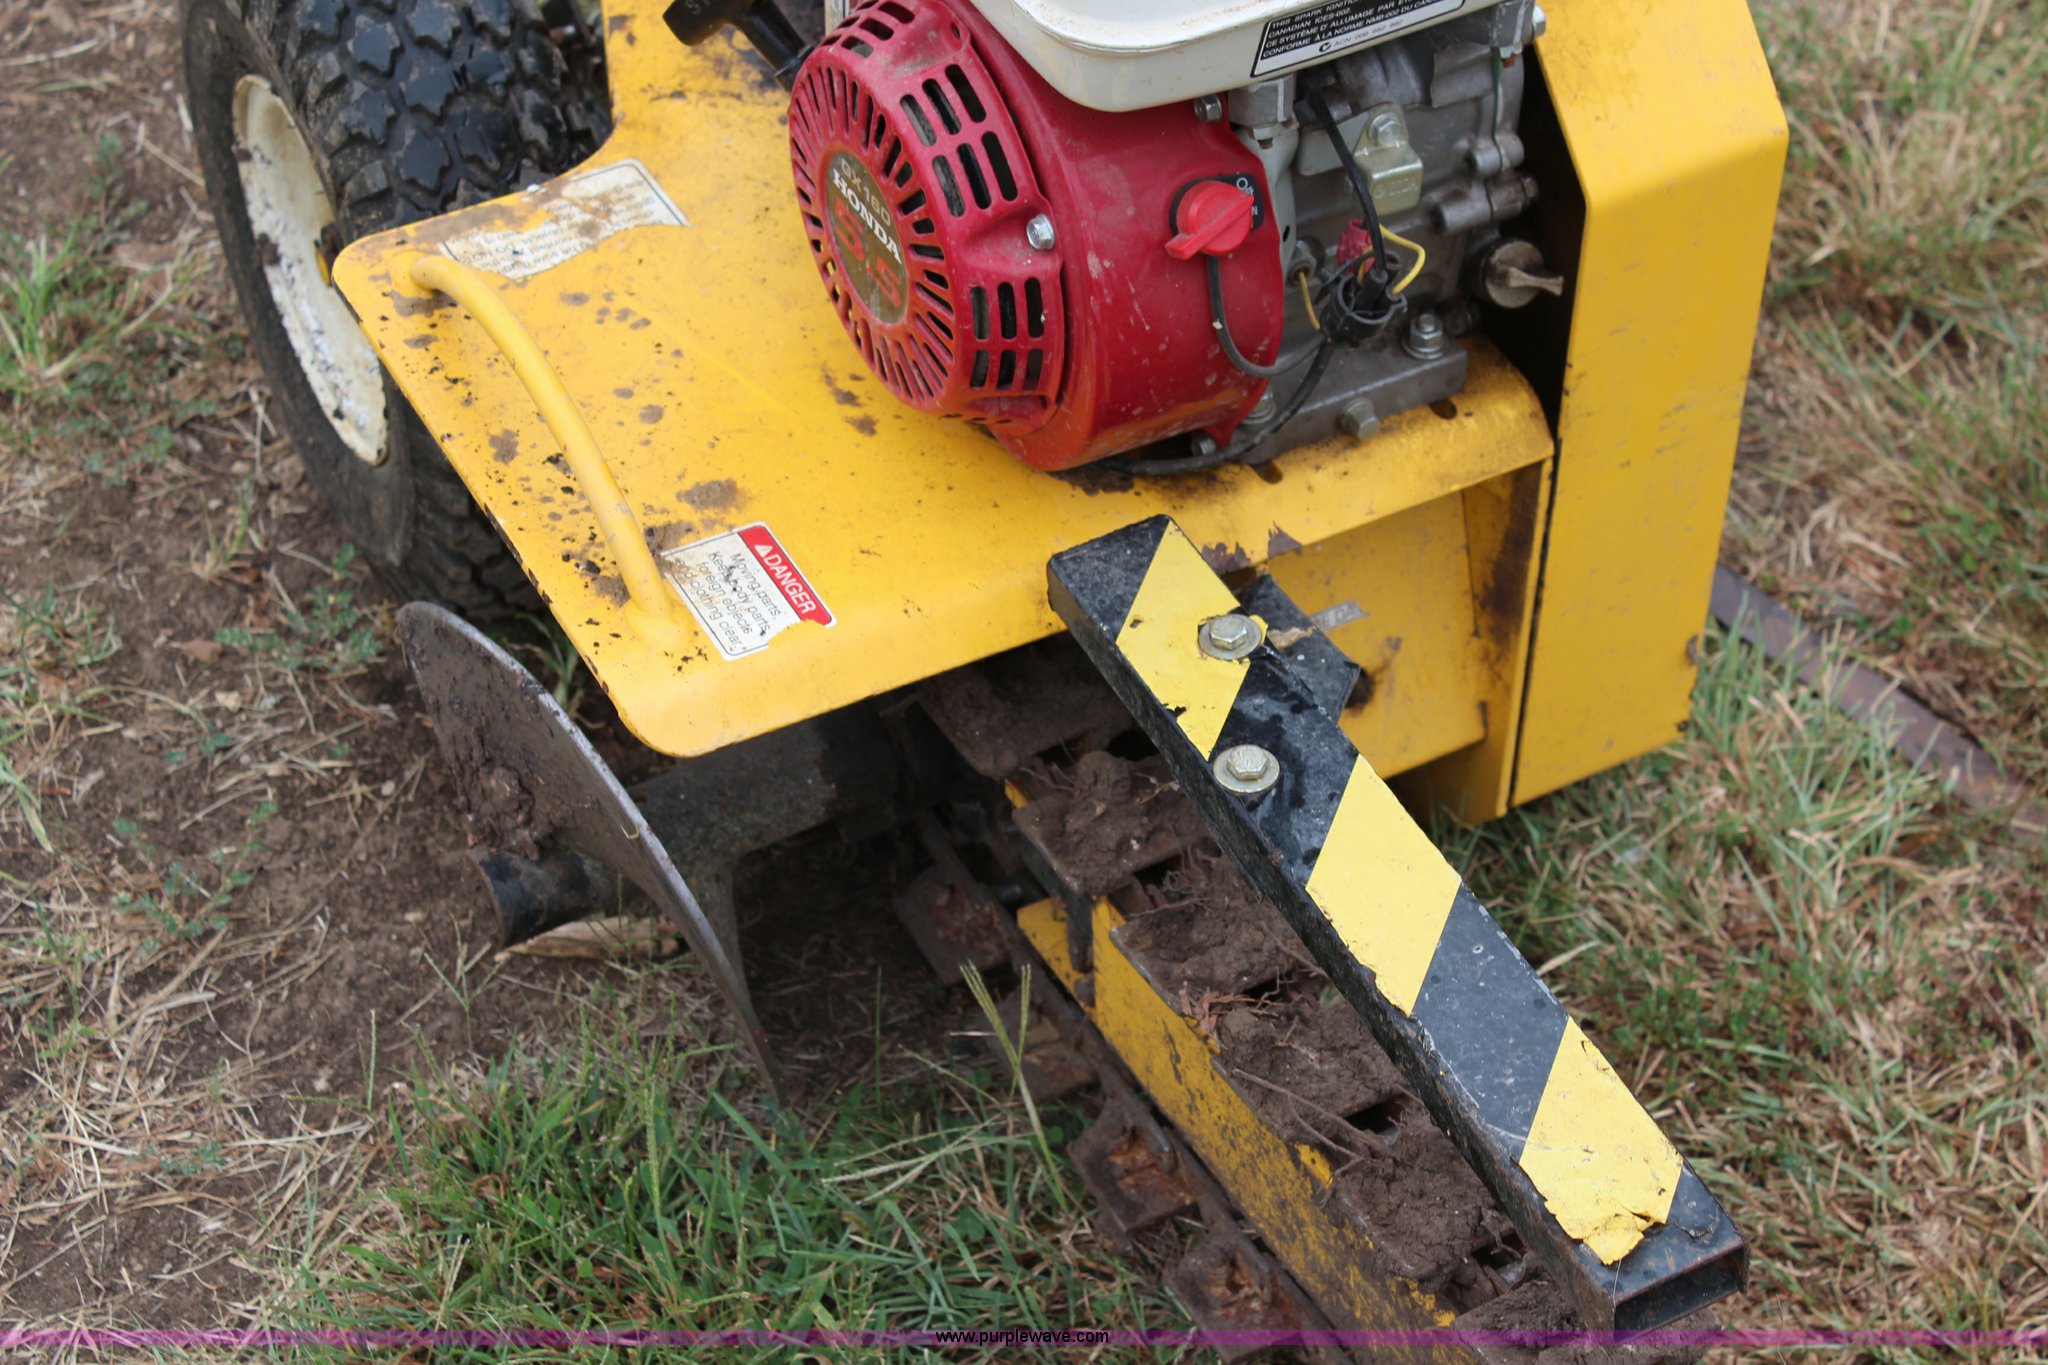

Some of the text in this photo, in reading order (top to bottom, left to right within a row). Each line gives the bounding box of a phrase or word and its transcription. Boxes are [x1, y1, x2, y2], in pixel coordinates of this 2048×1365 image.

[1263, 39, 1311, 58] CONFORME
[1321, 31, 1333, 40] LA
[1334, 21, 1365, 35] NORME
[1400, 5, 1413, 13] DU
[1265, 40, 1279, 48] CE
[1279, 27, 1319, 45] SYSTÈME
[1330, 8, 1375, 29] ALLUMAGE
[1377, 1, 1395, 13] PAR
[1268, 20, 1311, 39] CANADIAN
[1272, 17, 1291, 29] THIS
[1294, 8, 1323, 22] SPARK
[832, 168, 903, 265] HONDA
[834, 196, 901, 308] 5.5
[675, 558, 699, 580] and
[690, 580, 723, 621] clothing
[697, 561, 726, 597] foreign
[708, 551, 733, 581] Keep
[728, 579, 751, 604] body
[730, 552, 761, 593] Moving
[763, 554, 816, 614] DANGER
